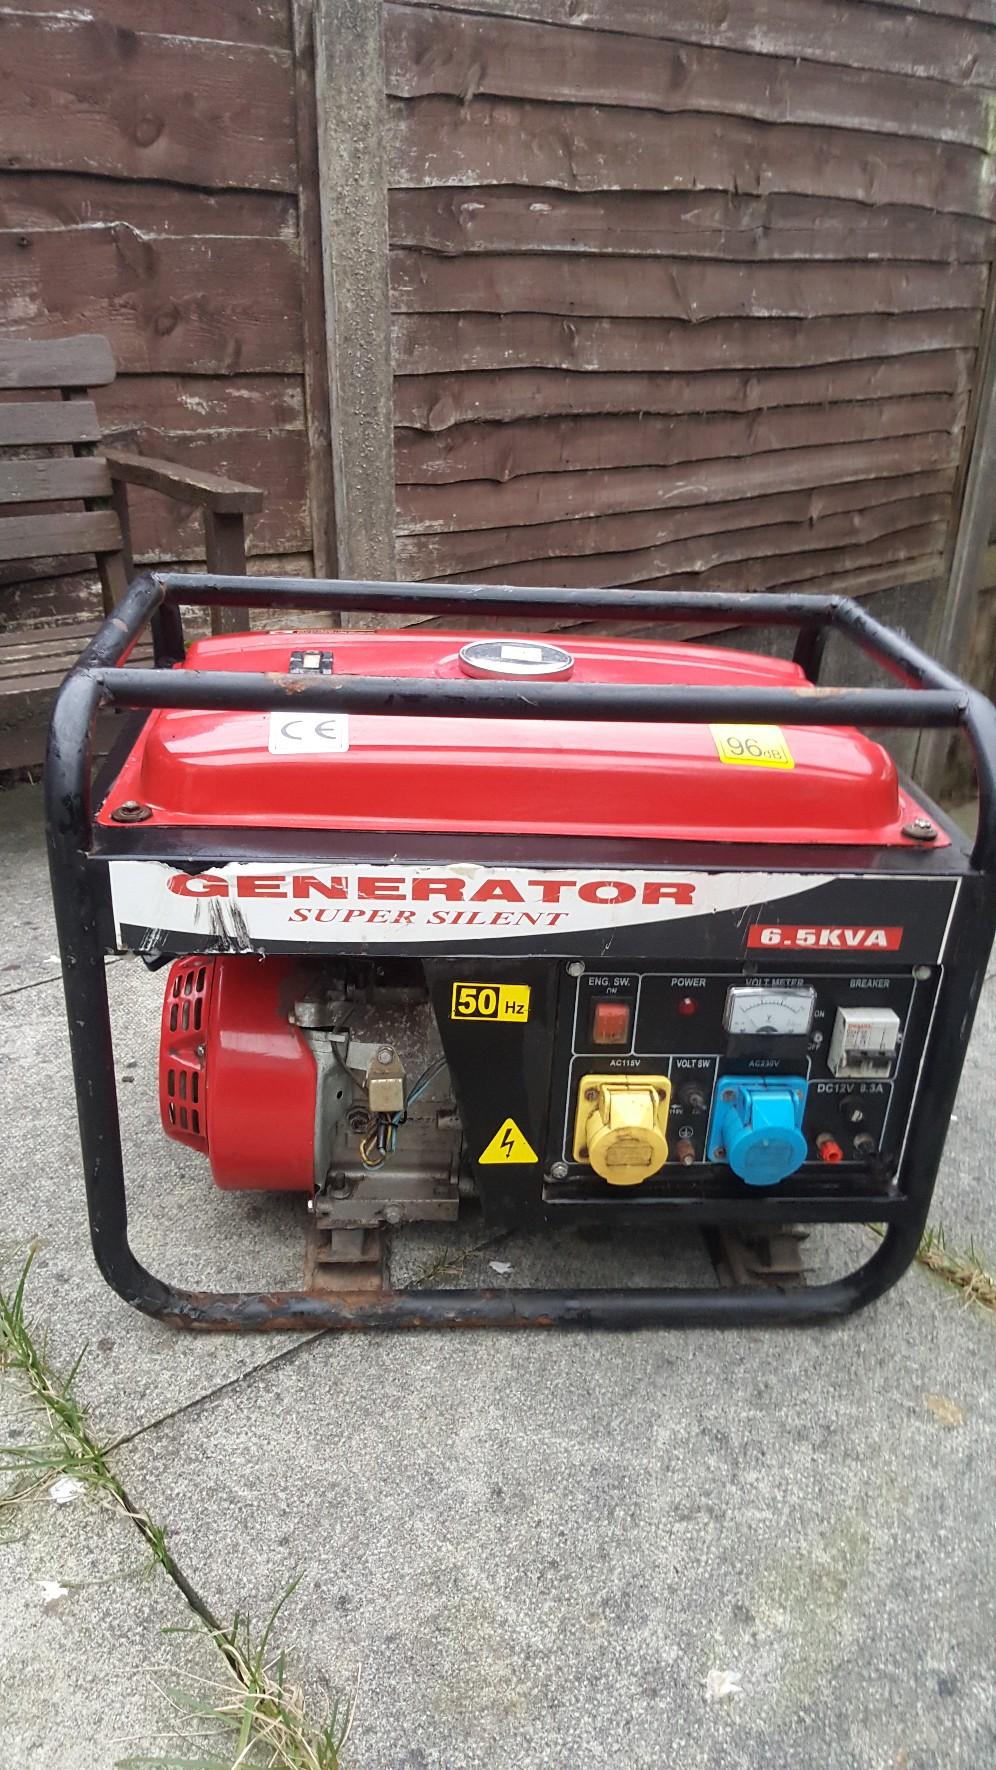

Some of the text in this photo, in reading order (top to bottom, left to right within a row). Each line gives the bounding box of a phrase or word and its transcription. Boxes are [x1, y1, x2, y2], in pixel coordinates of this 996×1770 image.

[167, 873, 696, 905] GENERATOR
[288, 908, 569, 926] SUPER SILENT
[760, 928, 888, 947] 6.5KVA
[671, 978, 706, 987] POWER
[849, 979, 890, 988] BREAKER
[458, 988, 525, 1015] 50 Hz
[814, 1010, 825, 1018] ON
[676, 1060, 710, 1069] VOLT SW
[817, 1084, 854, 1093] DC12V
